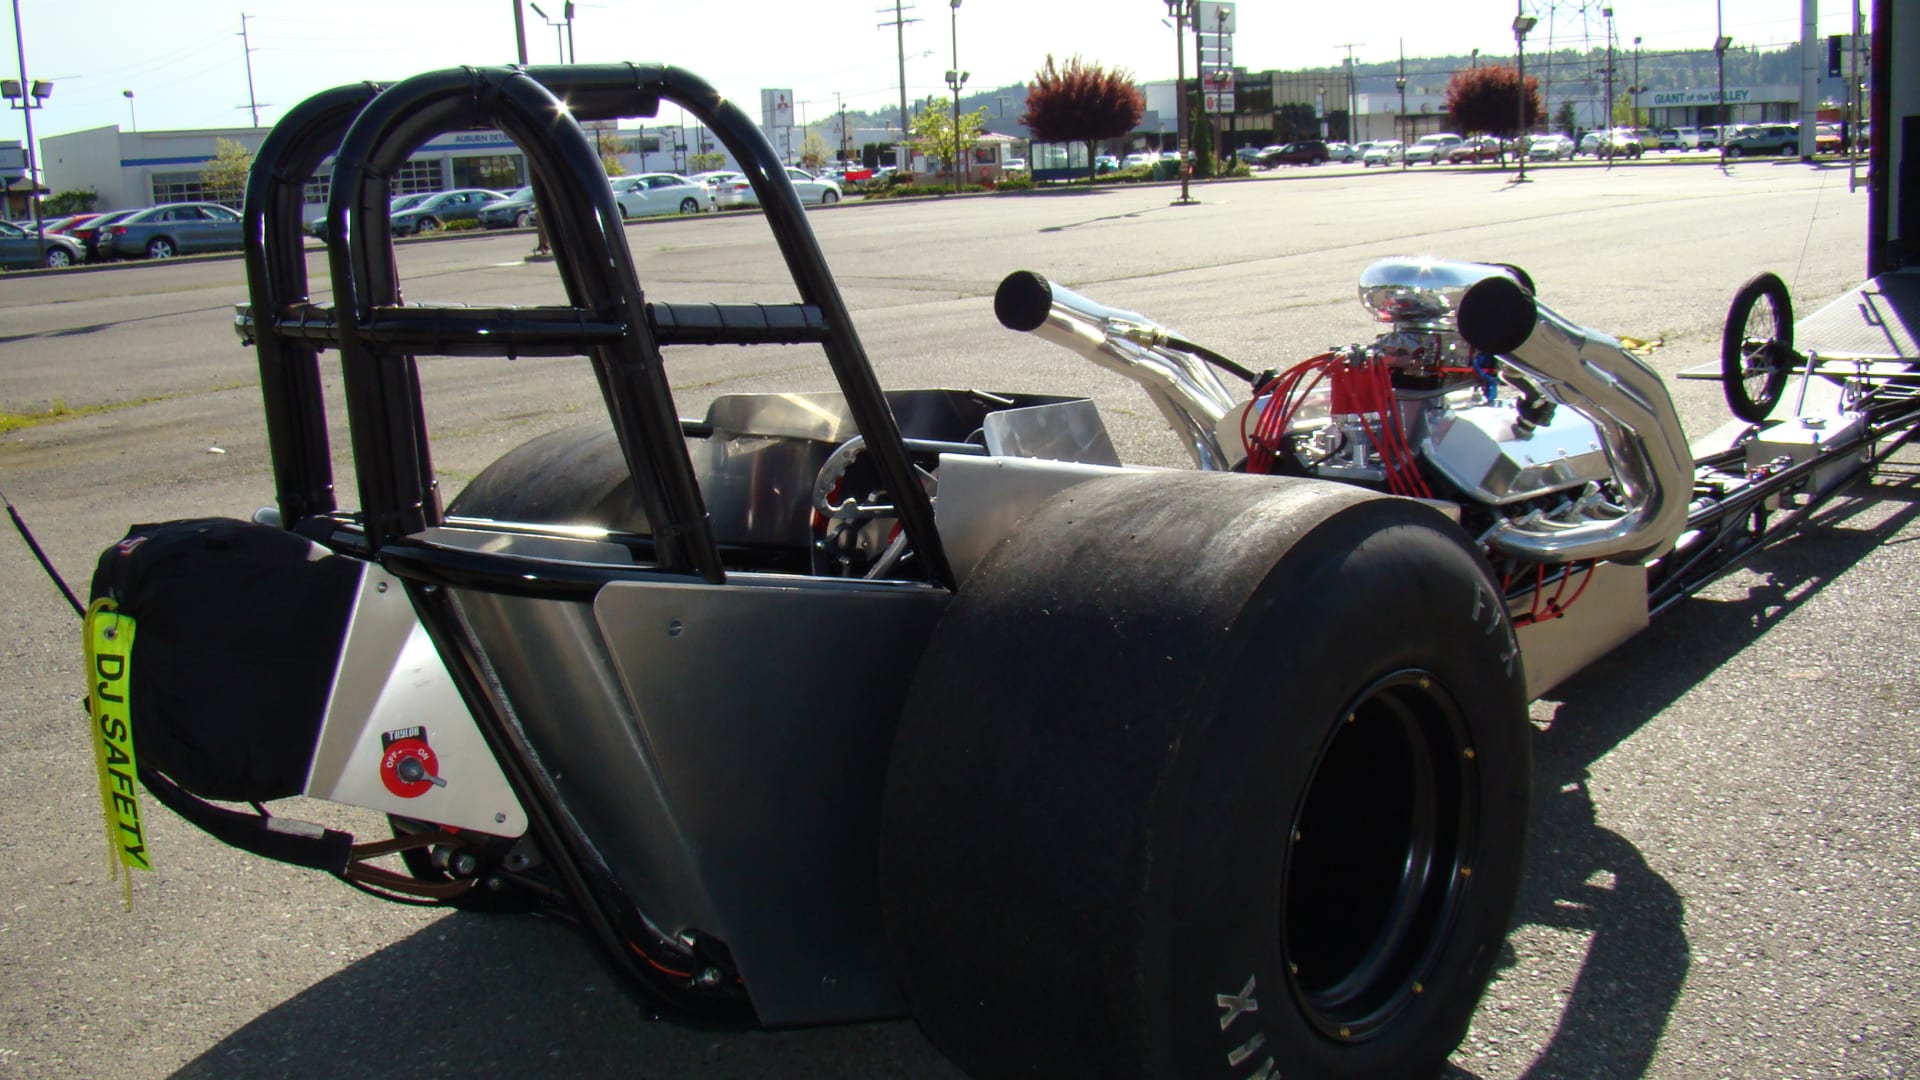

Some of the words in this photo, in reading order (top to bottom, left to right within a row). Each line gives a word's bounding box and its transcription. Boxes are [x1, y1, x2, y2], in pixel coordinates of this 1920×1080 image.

[1655, 93, 1685, 104] GIANT
[96, 653, 124, 703] DJ
[386, 751, 398, 768] OFF
[418, 748, 430, 760] ON
[101, 714, 149, 868] SAFETY
